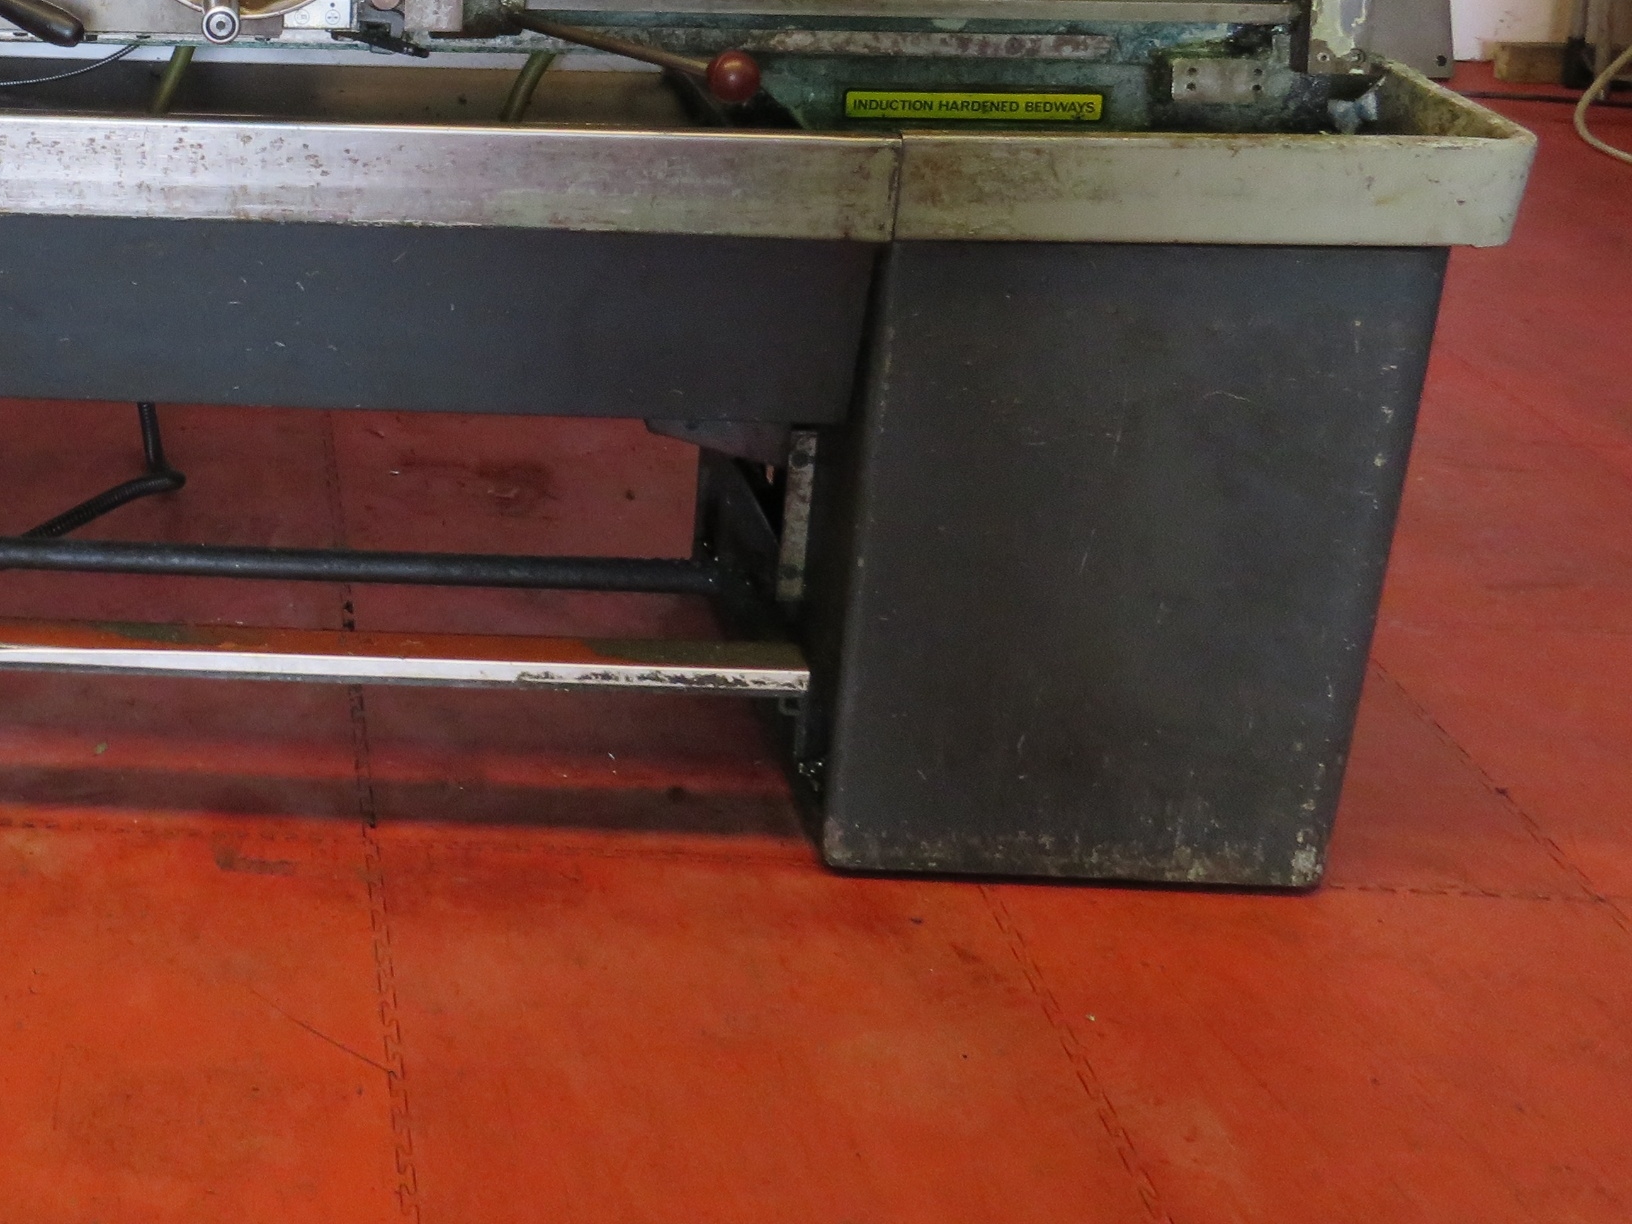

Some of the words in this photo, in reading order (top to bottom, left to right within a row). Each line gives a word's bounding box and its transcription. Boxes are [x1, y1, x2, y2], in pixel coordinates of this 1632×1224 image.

[853, 98, 933, 111] INDUCTION
[938, 99, 1019, 112] HARDENED
[1025, 101, 1095, 114] BEDWAYS
